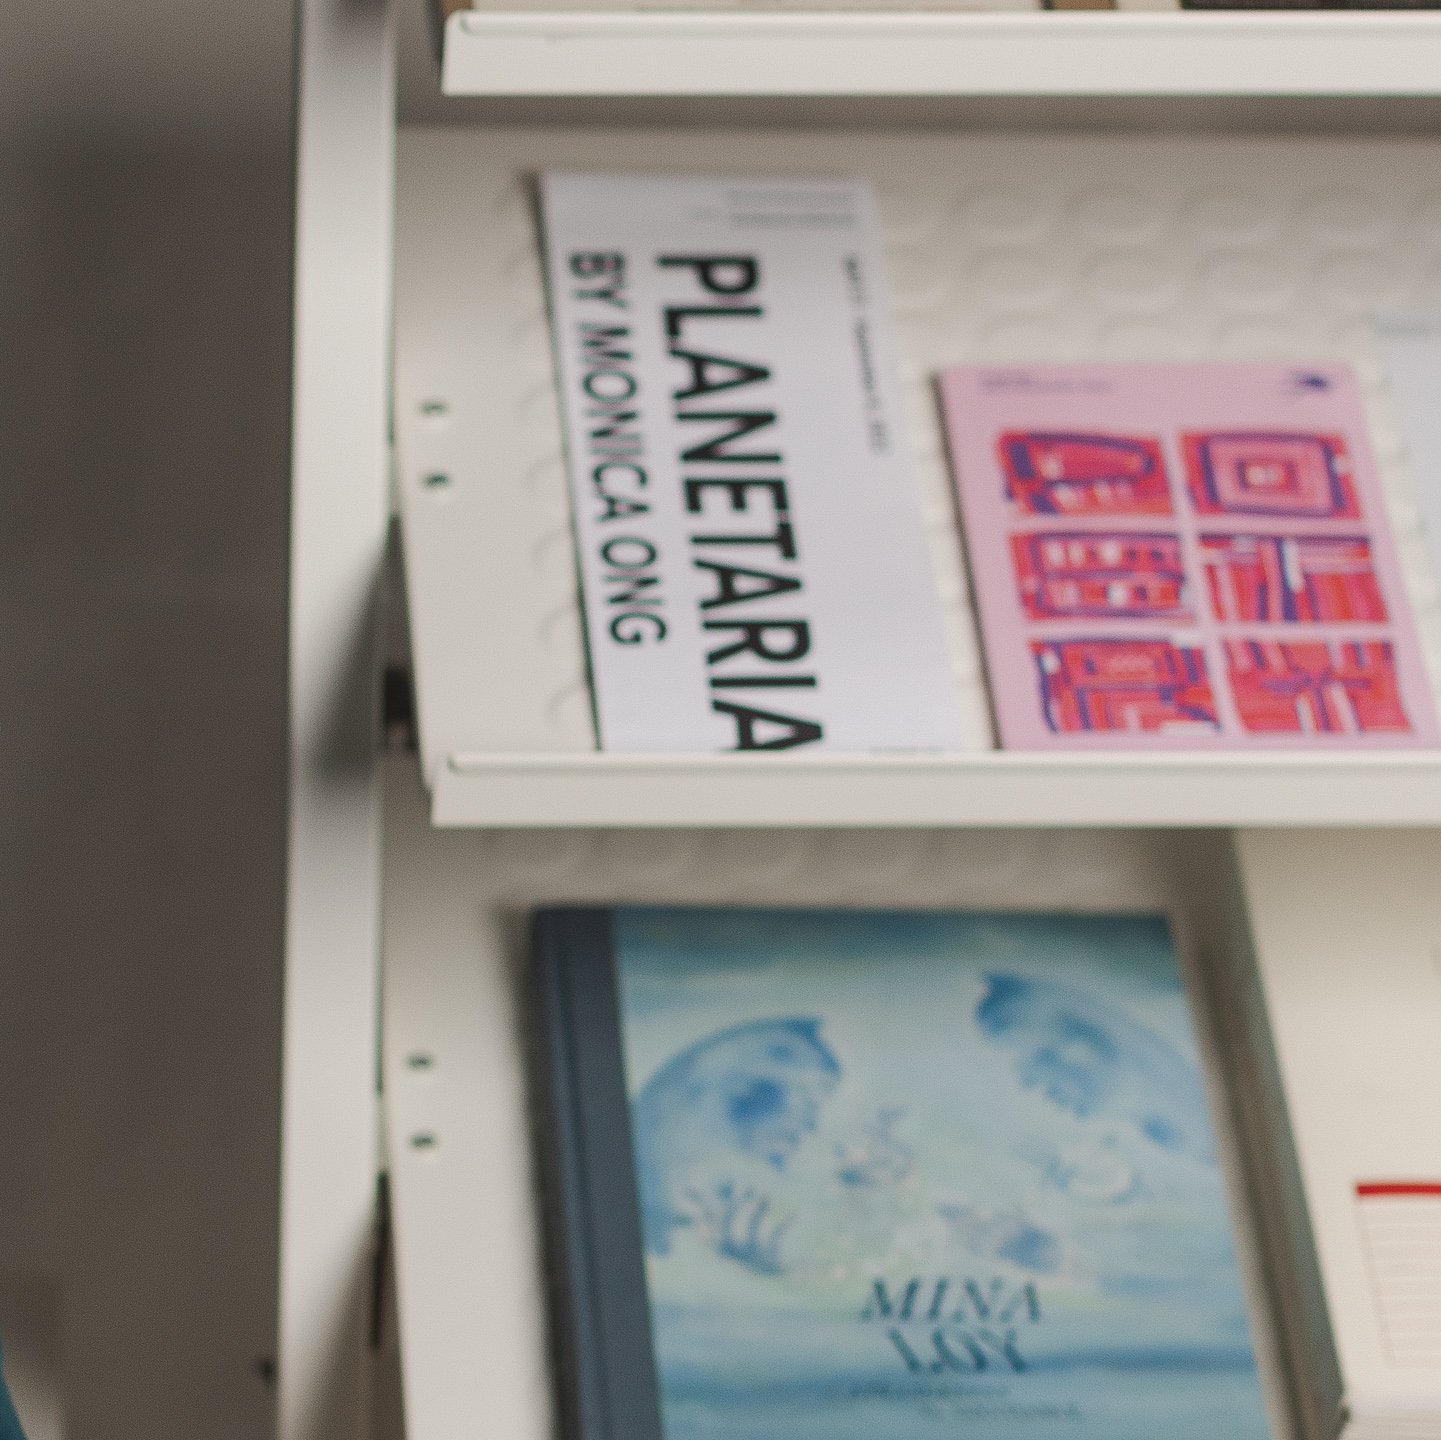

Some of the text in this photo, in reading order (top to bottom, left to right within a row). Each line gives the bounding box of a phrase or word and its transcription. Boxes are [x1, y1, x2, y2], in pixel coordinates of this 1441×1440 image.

[569, 251, 667, 645] BY MONICA ONG
[658, 252, 824, 751] PLANETARIA
[857, 1275, 1041, 1323] MINA
[888, 1326, 1028, 1375] LOY
